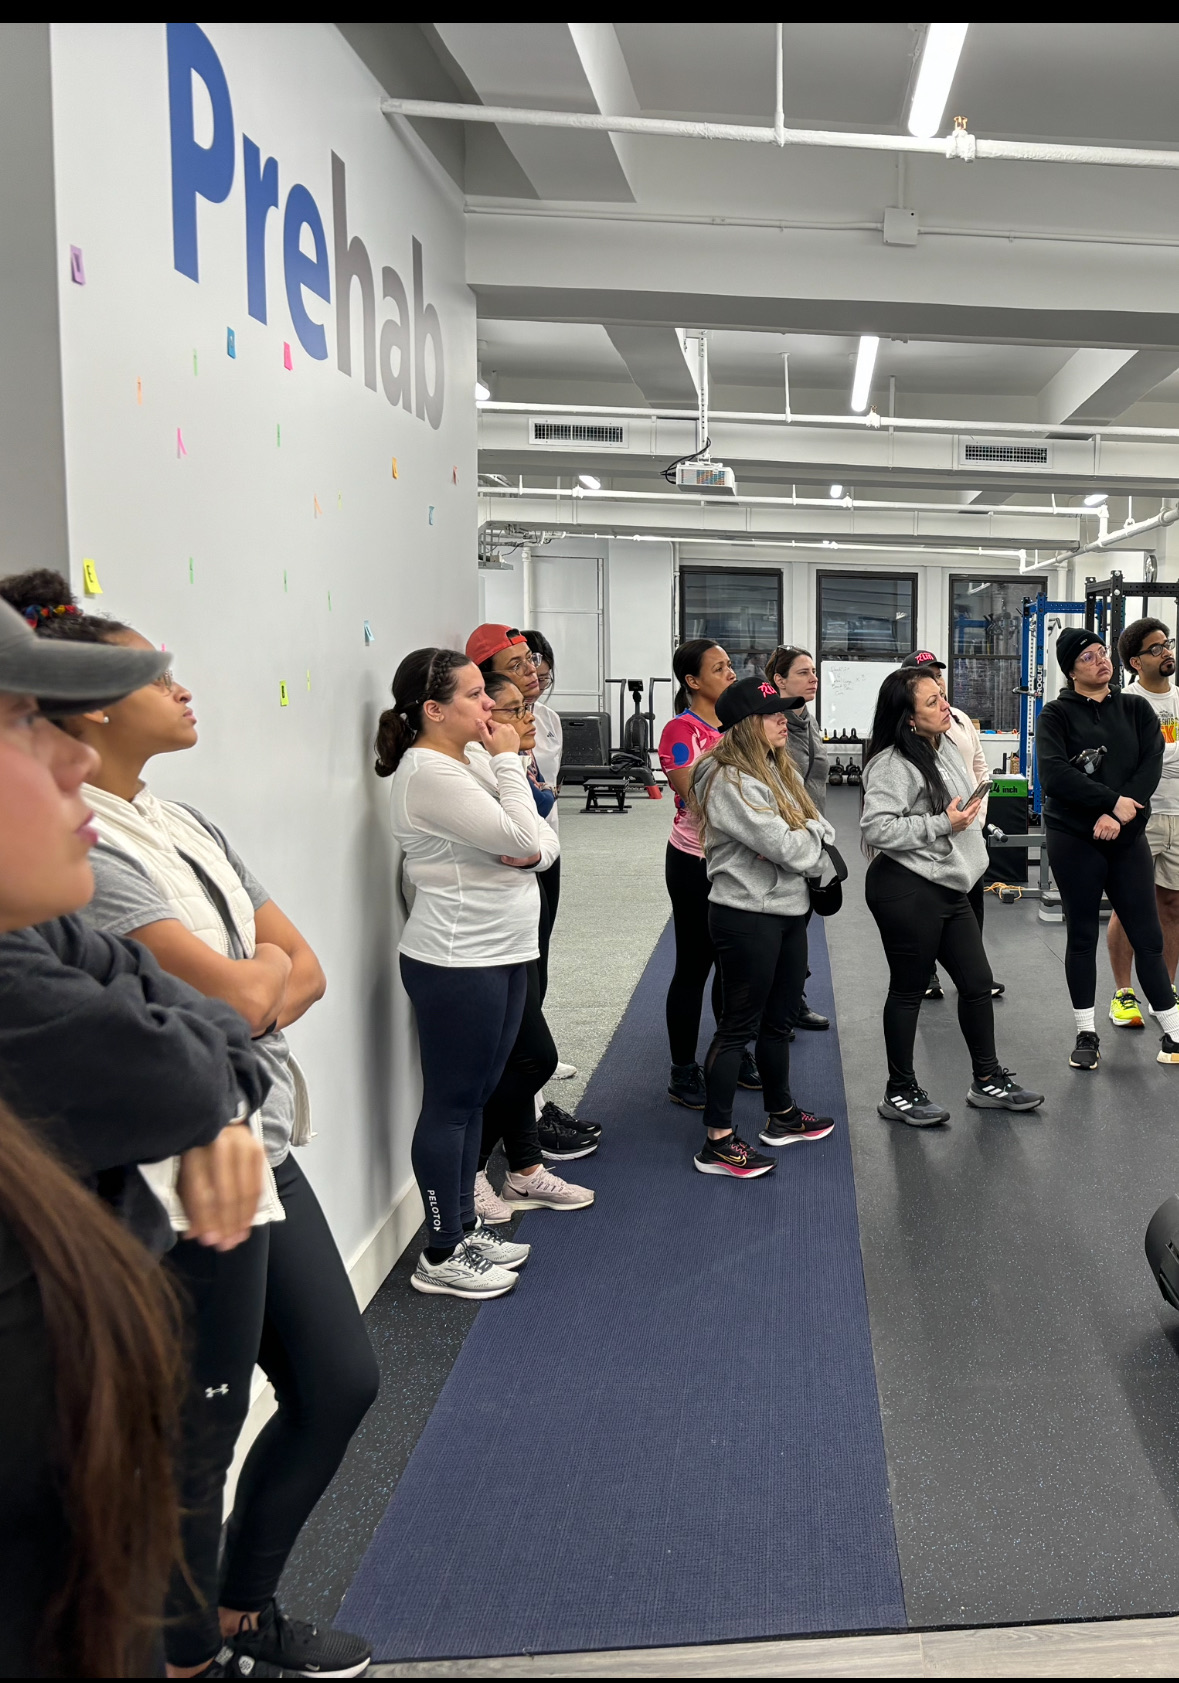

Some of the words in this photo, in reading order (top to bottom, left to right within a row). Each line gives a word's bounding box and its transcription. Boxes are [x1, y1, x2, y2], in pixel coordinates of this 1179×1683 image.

[166, 23, 444, 430] Prehab
[989, 783, 1000, 793] 4
[1002, 785, 1018, 793] inch
